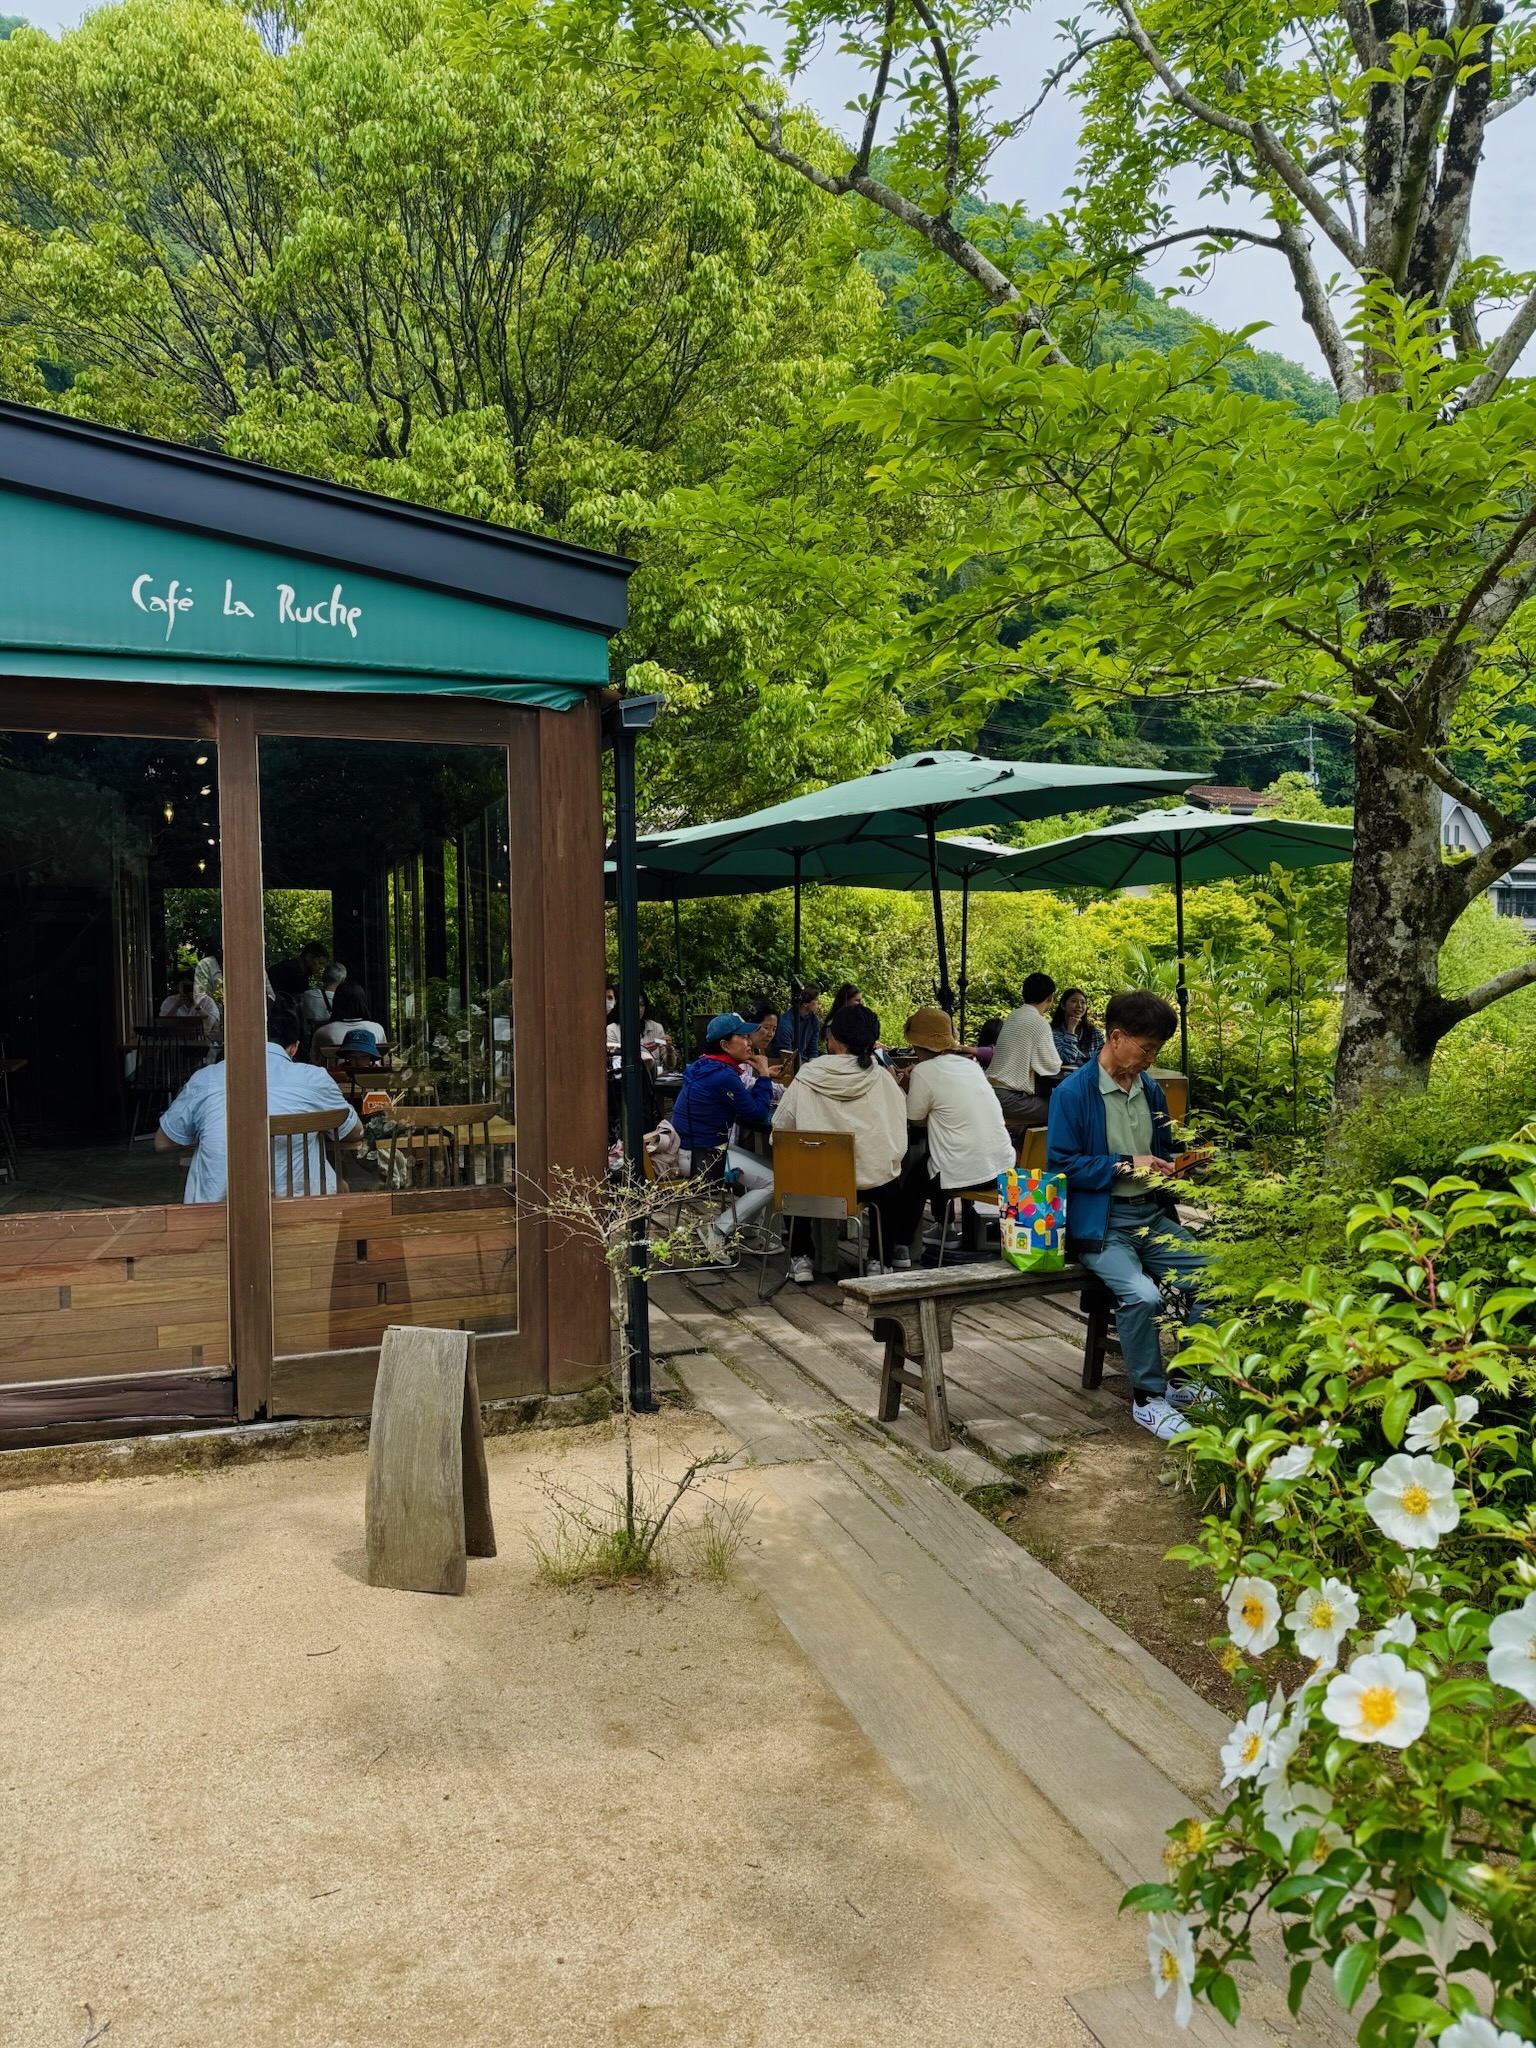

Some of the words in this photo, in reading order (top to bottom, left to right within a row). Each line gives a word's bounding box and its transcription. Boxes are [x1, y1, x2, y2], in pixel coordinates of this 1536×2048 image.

[131, 573, 194, 642] Café
[223, 578, 255, 618] La
[276, 583, 362, 638] Ruche
